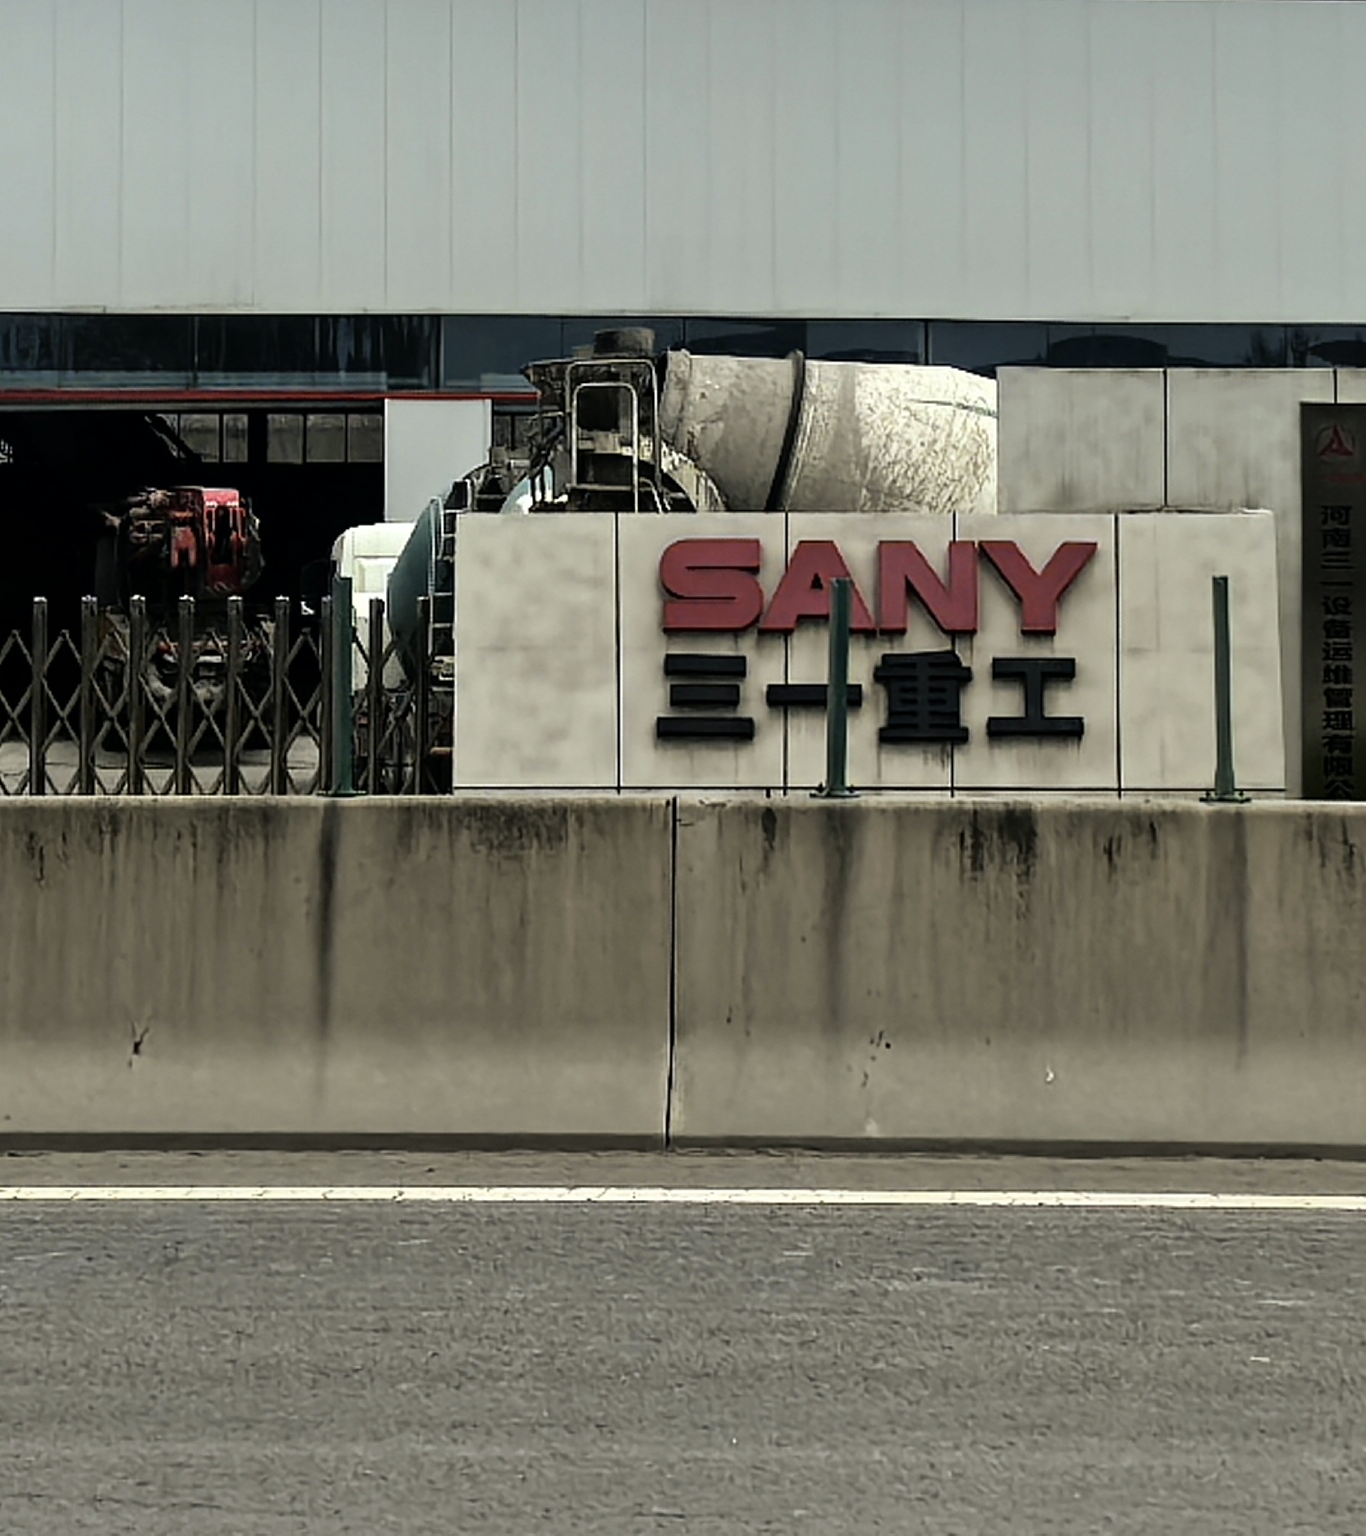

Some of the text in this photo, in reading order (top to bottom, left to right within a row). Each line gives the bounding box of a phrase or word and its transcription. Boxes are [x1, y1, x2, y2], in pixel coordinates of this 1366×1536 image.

[659, 537, 1098, 636] SANY
[655, 650, 1085, 744] 三一重工
